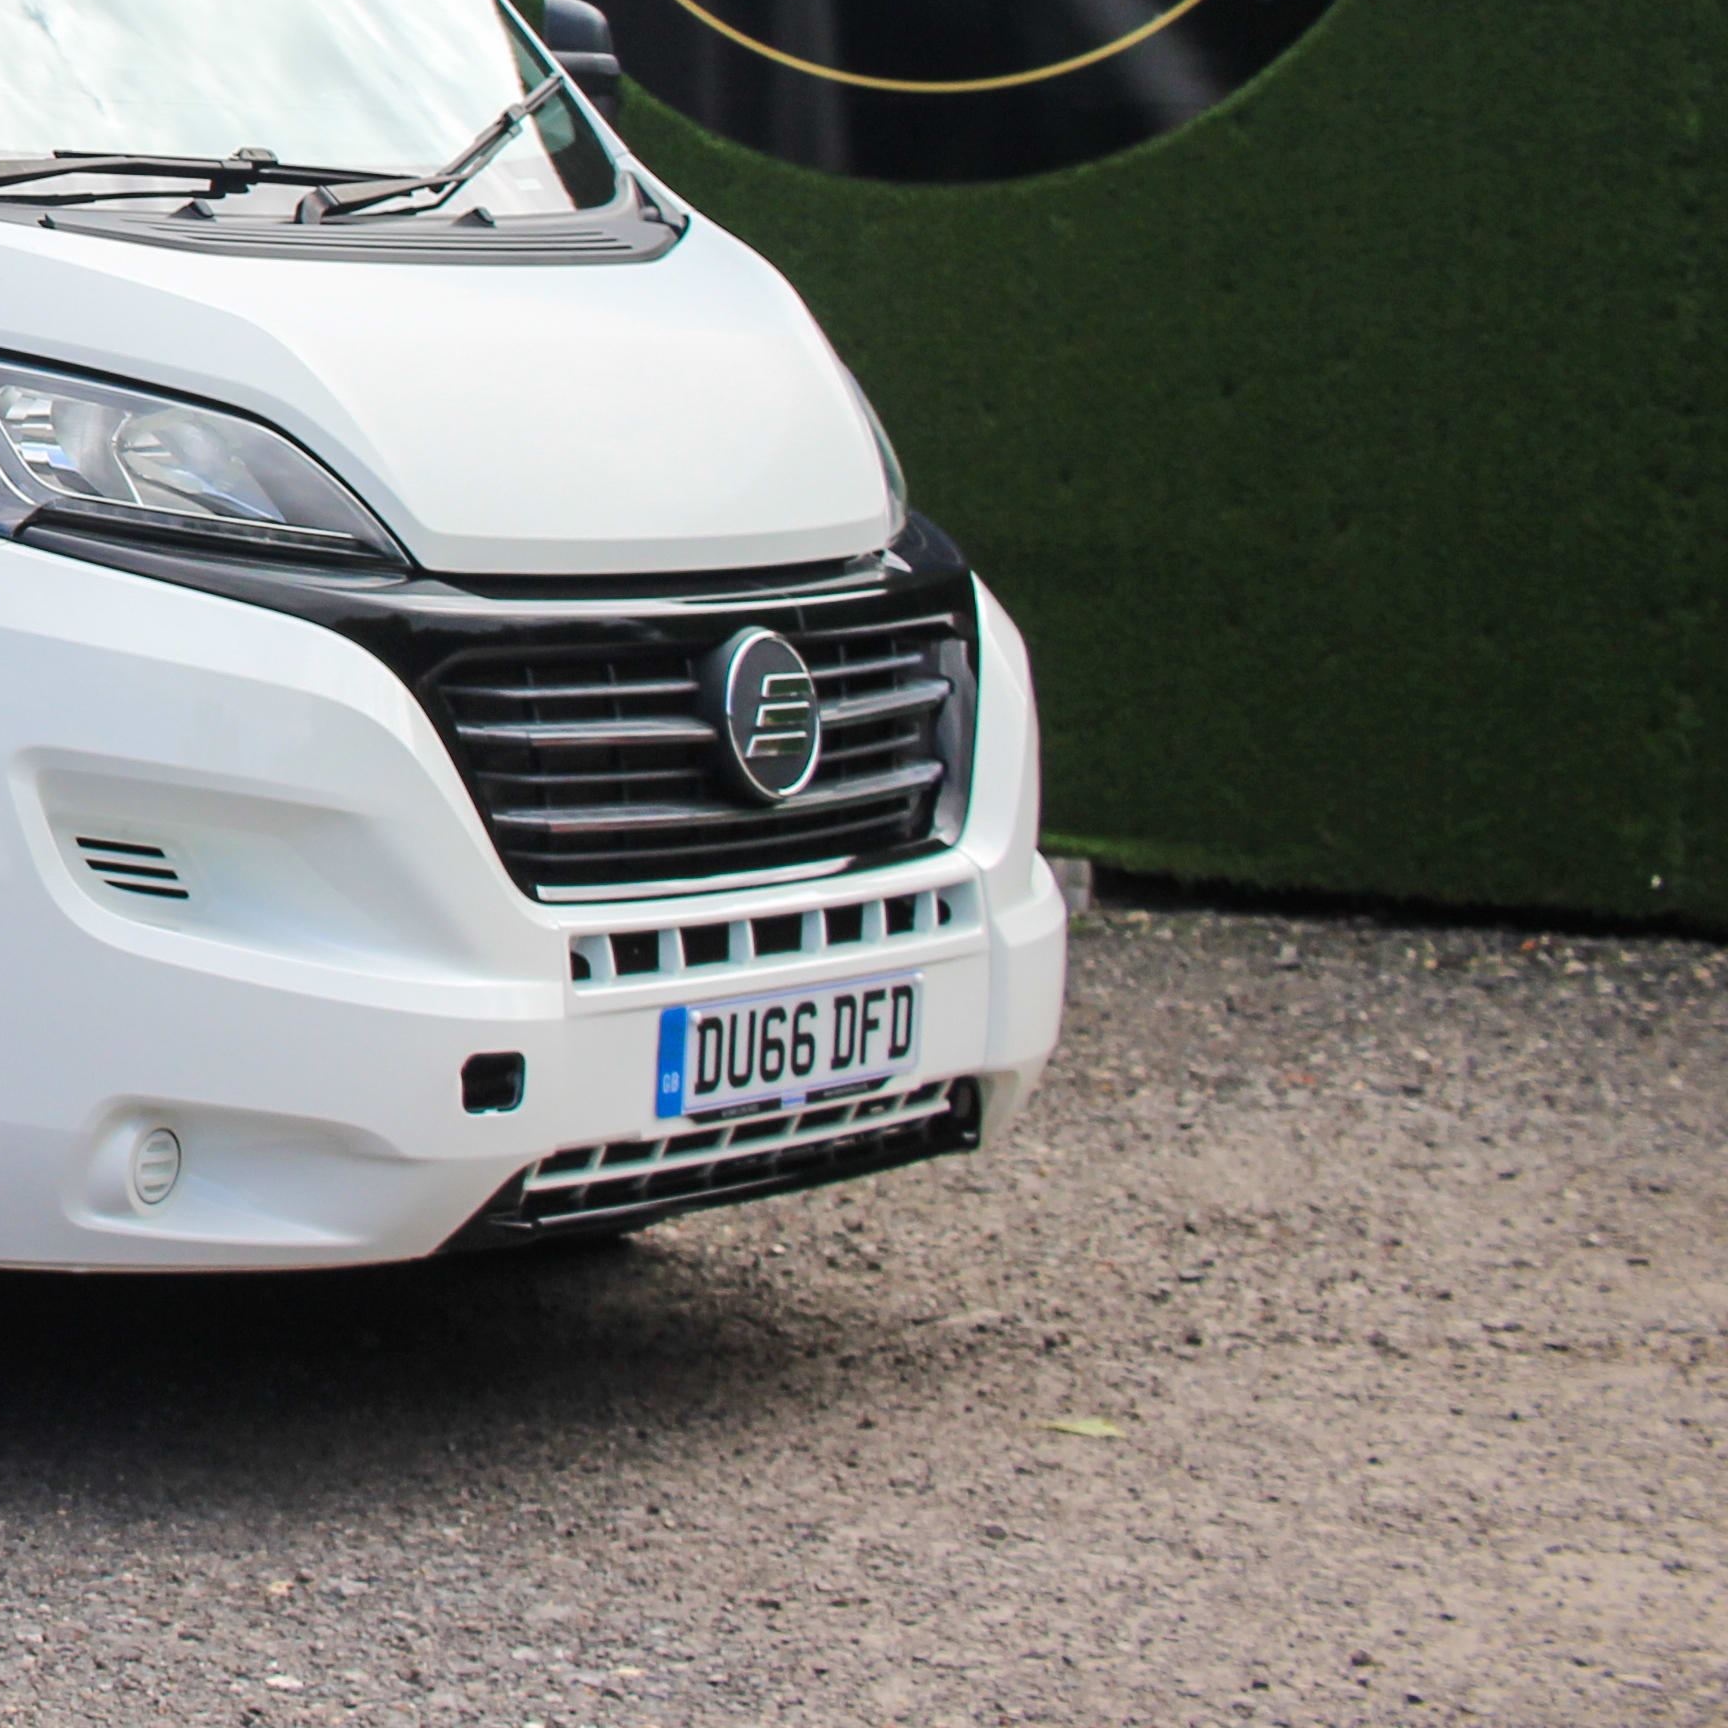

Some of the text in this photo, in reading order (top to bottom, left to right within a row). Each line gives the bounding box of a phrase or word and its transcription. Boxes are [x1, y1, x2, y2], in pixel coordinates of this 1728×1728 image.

[694, 985, 914, 1095] DU66 DFD
[663, 1071, 680, 1094] GB
